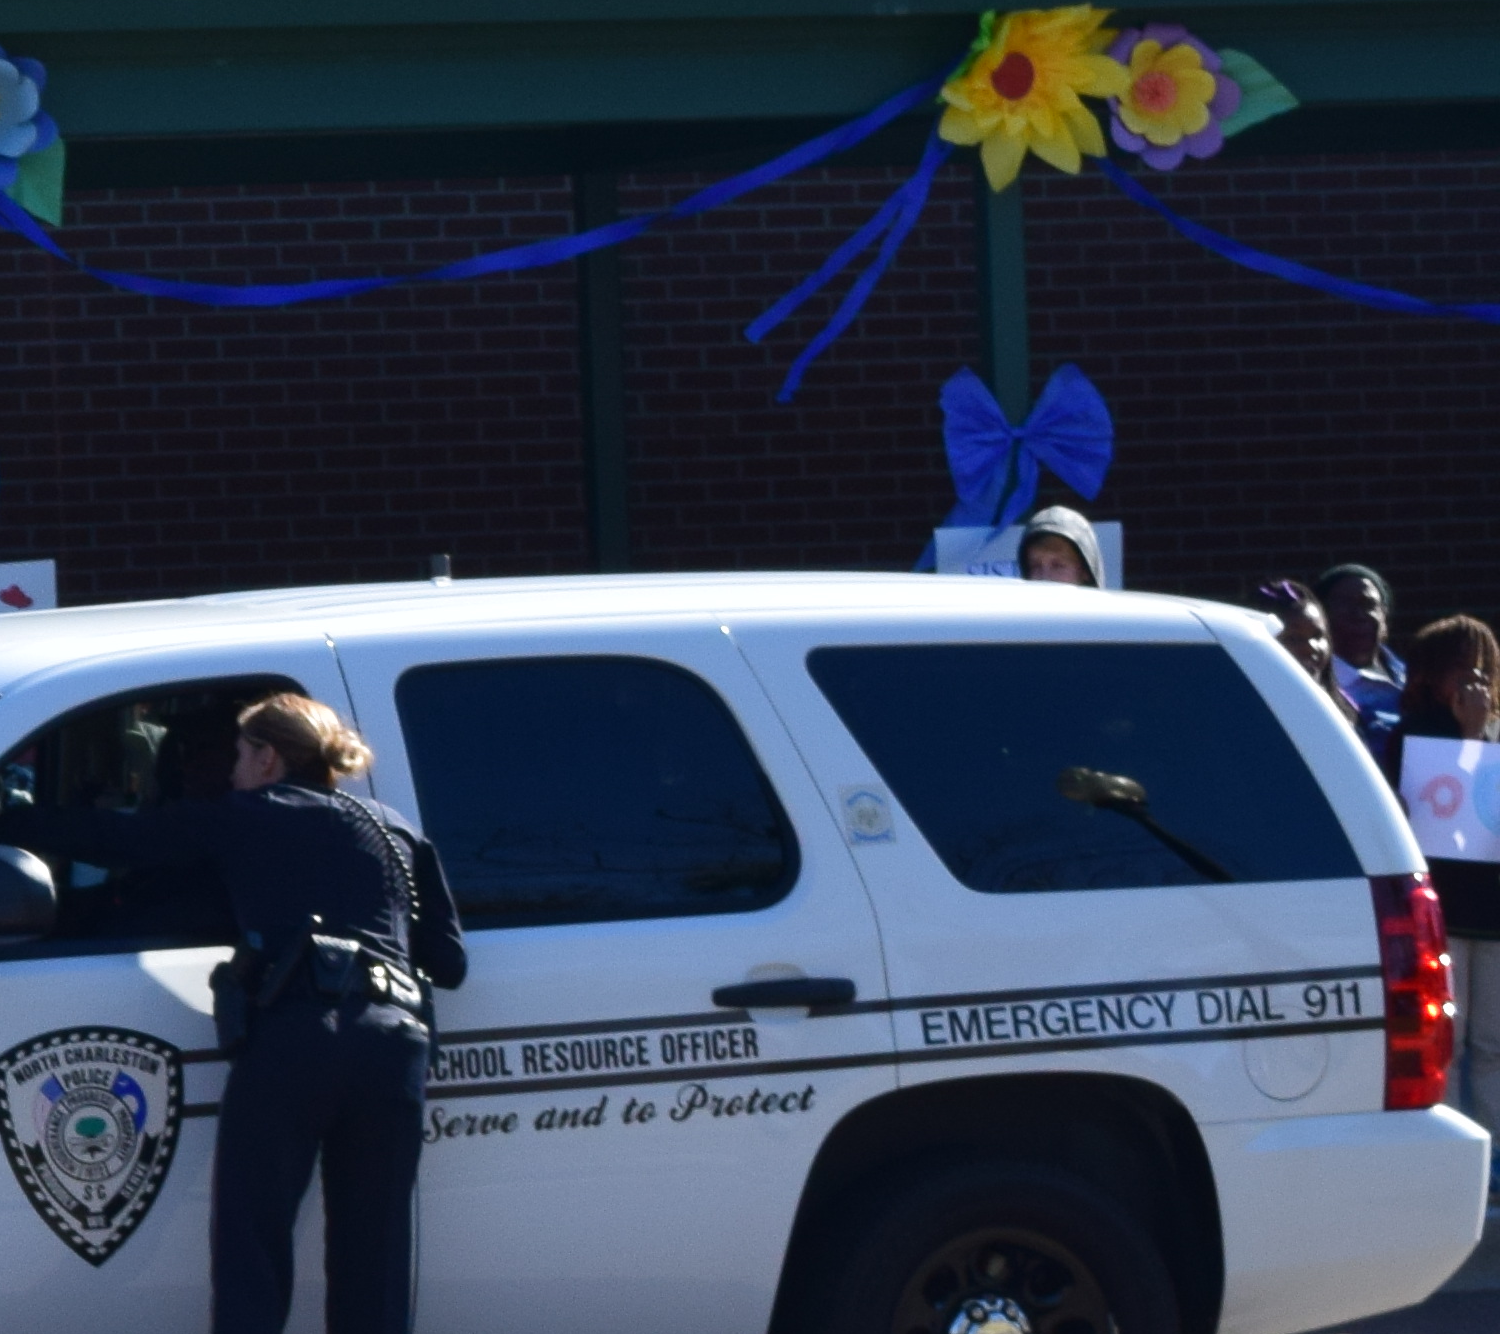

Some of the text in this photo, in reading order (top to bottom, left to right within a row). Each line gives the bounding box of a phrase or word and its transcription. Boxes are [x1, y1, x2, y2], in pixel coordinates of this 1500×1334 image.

[921, 982, 1363, 1046] EMERGENCY DIAL 911
[13, 1046, 161, 1086] NORTH CHARLESTON
[522, 1036, 651, 1076] RESOURCE
[660, 1027, 760, 1065] OFFICER
[62, 1068, 112, 1089] POLICE
[423, 1083, 817, 1144] Serve and to Protect
